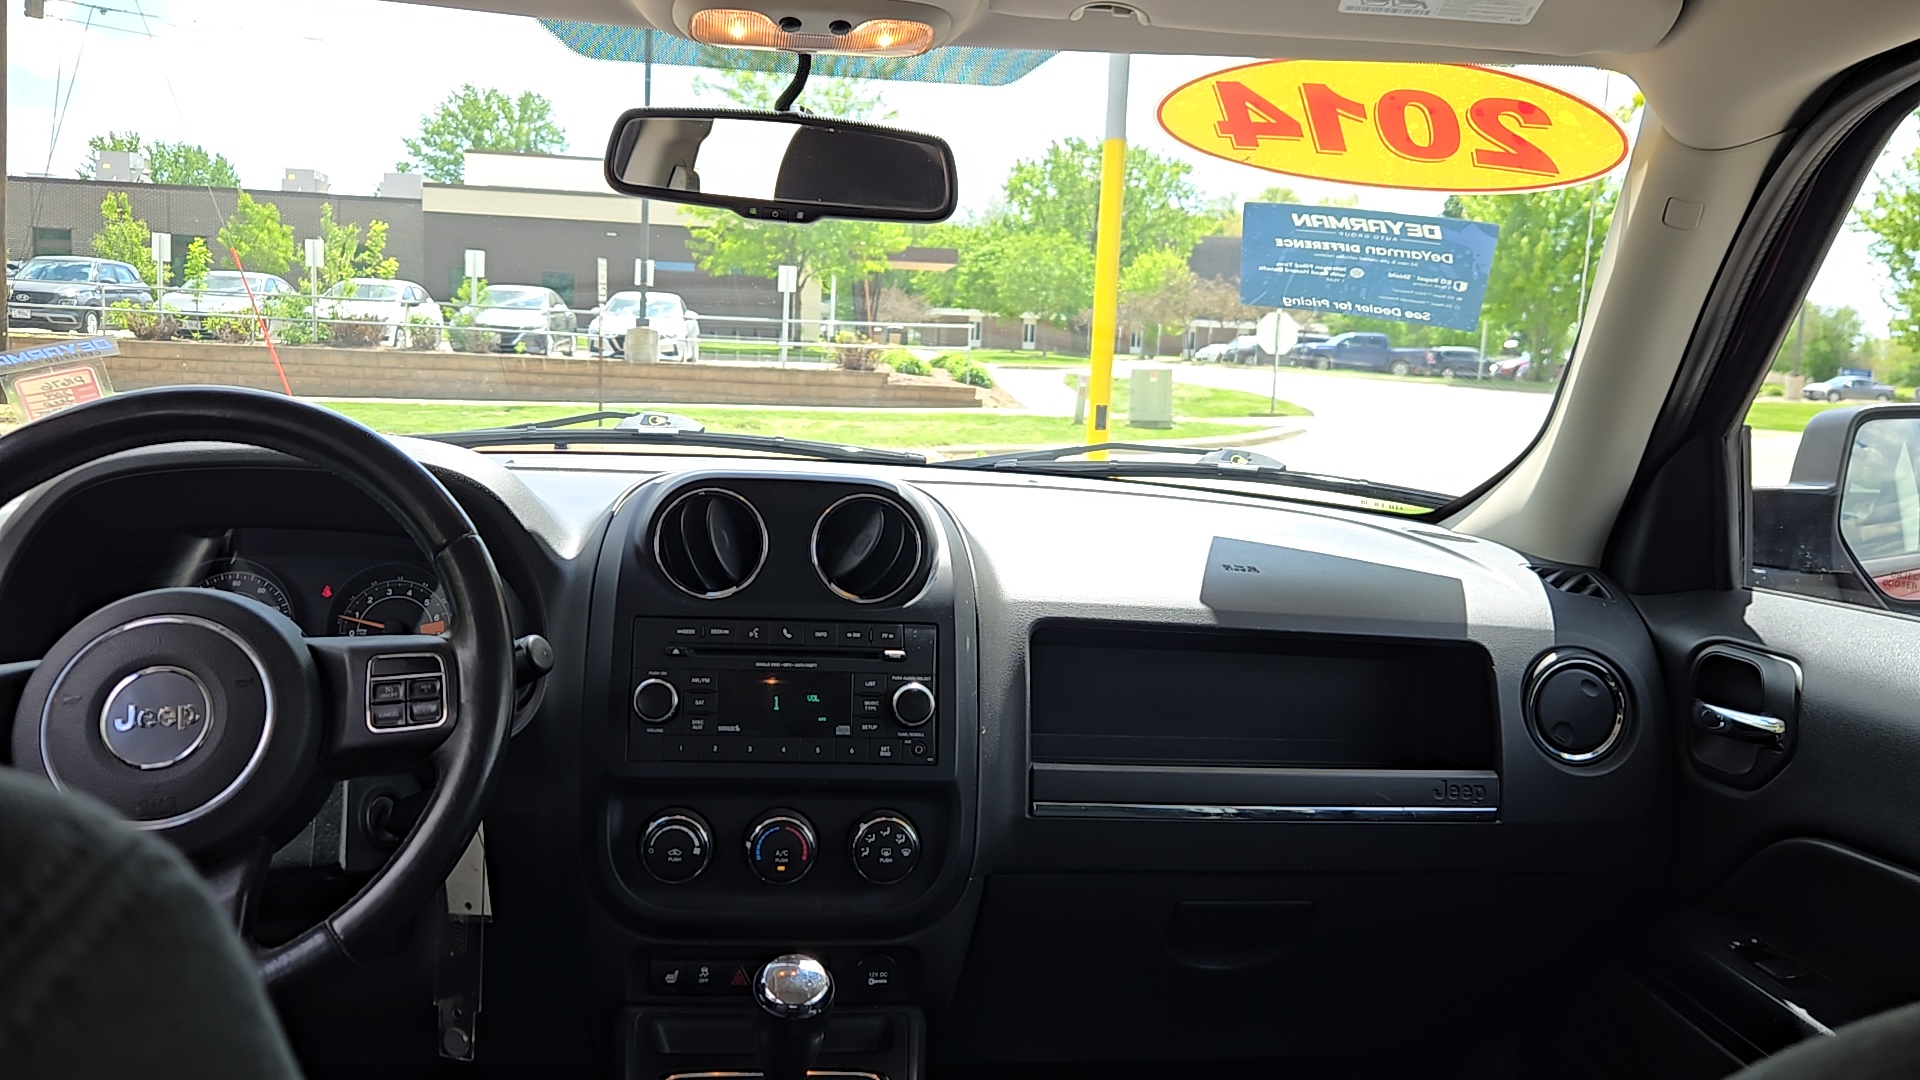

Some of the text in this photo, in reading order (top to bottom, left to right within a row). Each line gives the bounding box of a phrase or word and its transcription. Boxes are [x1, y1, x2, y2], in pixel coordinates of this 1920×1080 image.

[1882, 579, 1918, 589] CLOSER
[773, 695, 780, 711] 1
[806, 694, 821, 702] VOL
[113, 703, 201, 732] Jeep
[1433, 780, 1486, 804] Jeep
[775, 849, 789, 857] A/C
